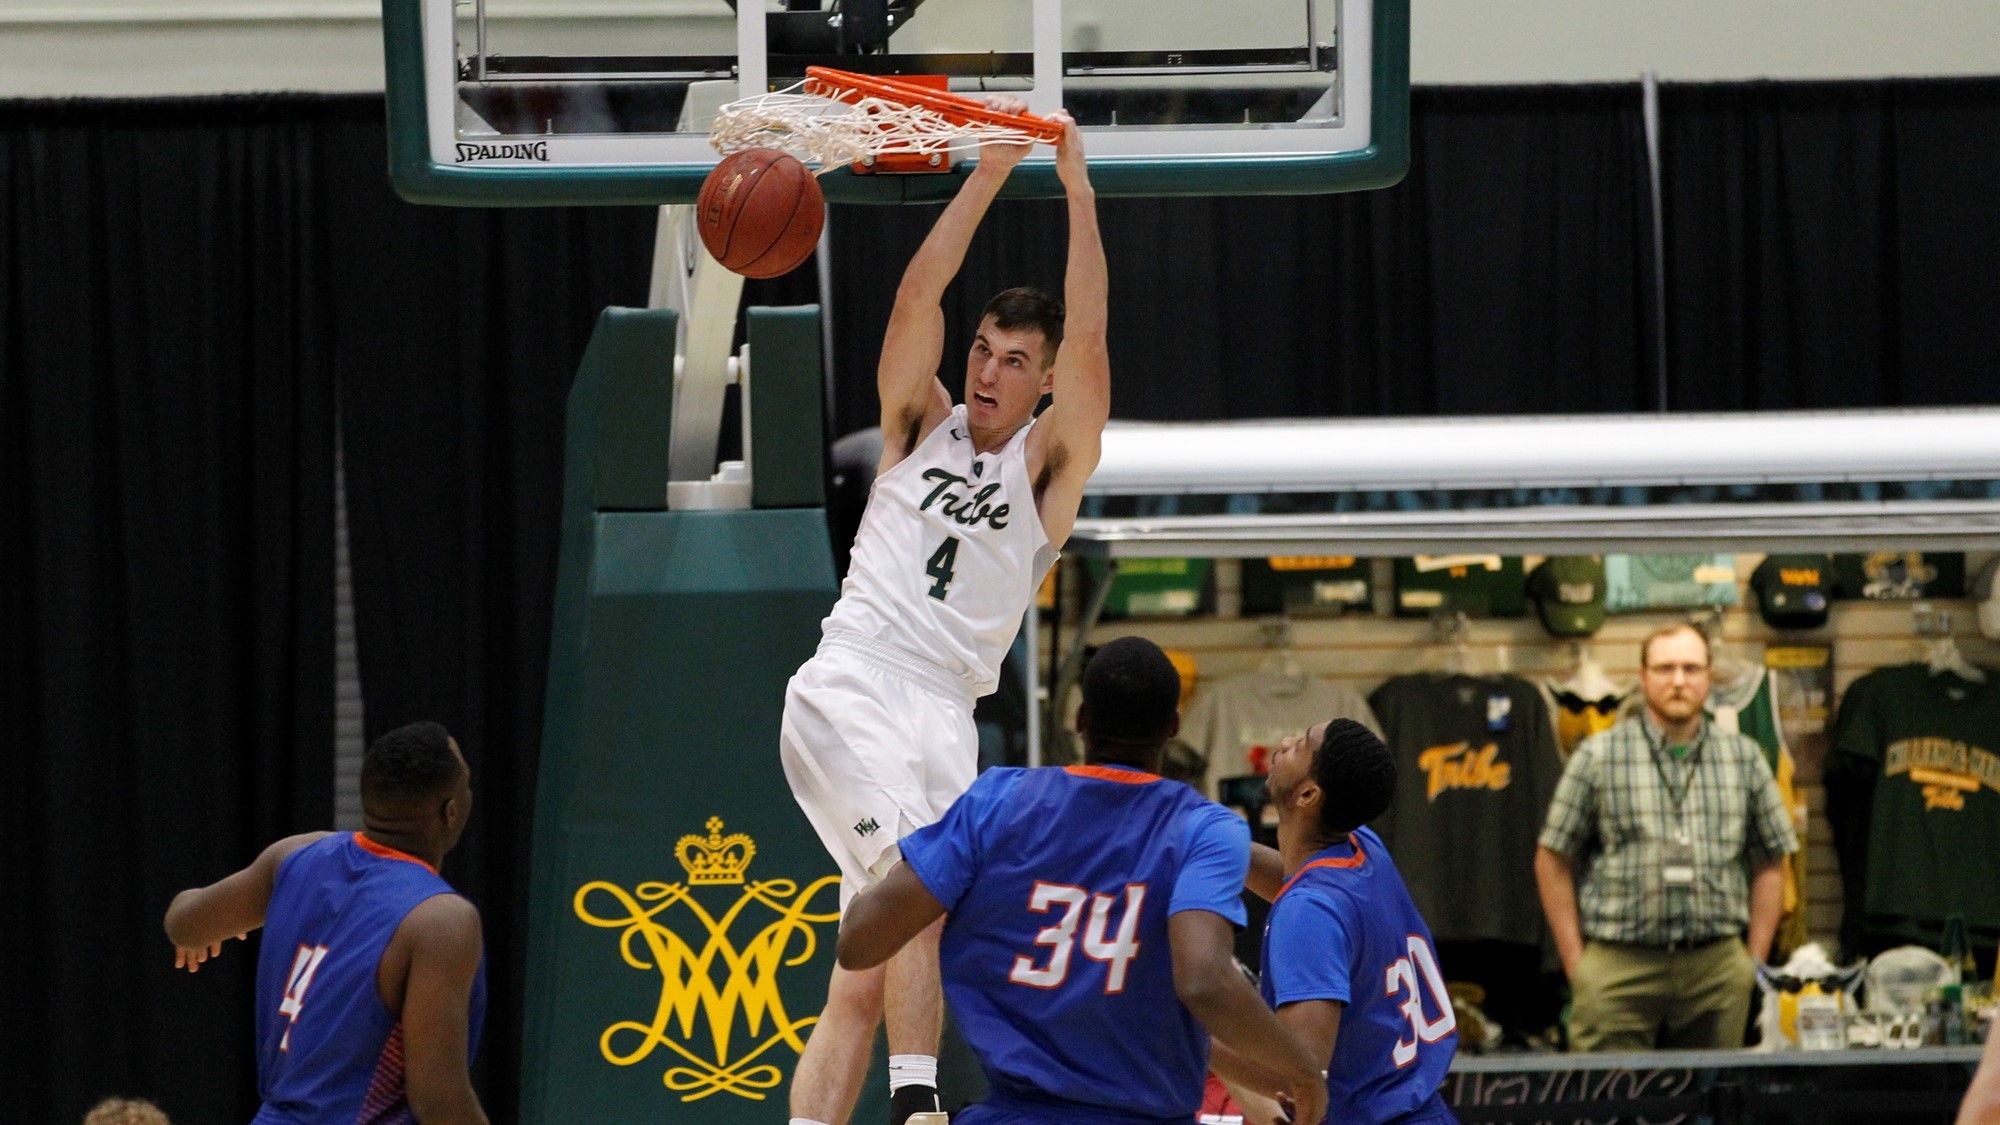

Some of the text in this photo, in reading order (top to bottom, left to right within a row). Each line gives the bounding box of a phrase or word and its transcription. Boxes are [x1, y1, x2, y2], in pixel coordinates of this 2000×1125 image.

[455, 141, 550, 163] SPALDING
[920, 467, 1010, 530] Tribe
[926, 536, 960, 601] 4
[1418, 741, 1511, 803] Tribe
[1009, 880, 1147, 993] 34
[280, 944, 328, 1051] 4
[1385, 933, 1457, 1068] 30
